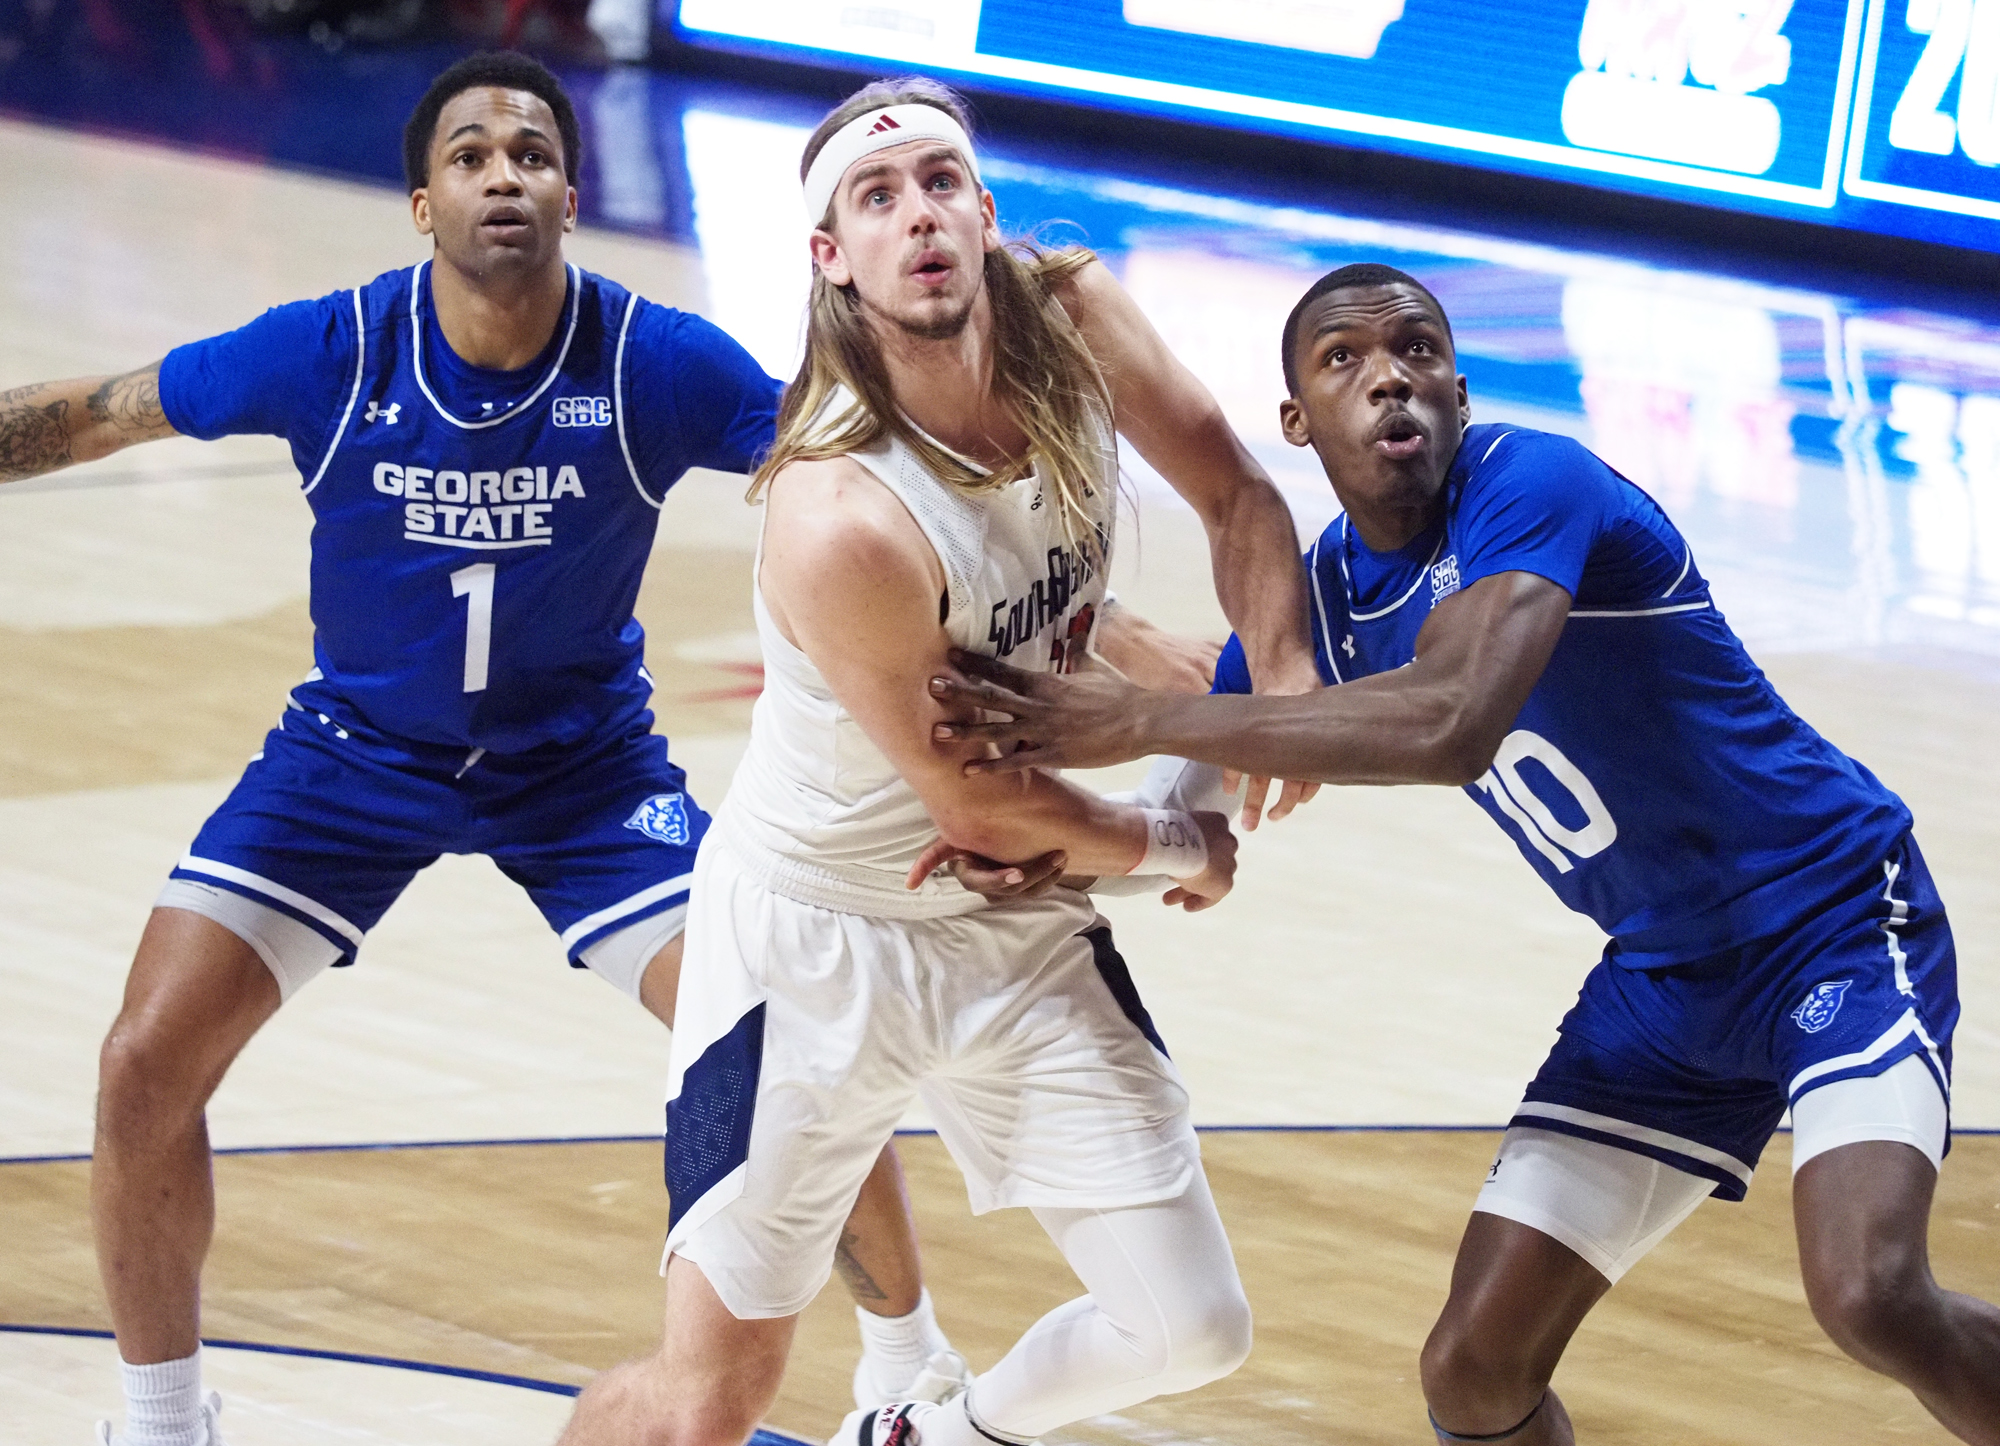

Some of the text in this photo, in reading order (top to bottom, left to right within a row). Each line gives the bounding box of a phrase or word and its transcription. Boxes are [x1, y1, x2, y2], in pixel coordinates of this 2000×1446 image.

[553, 397, 612, 427] SBC
[373, 462, 586, 504] GEORGIA
[405, 503, 553, 540] STATE
[450, 563, 496, 693] 1
[988, 579, 1055, 661] SOUH
[1474, 730, 1618, 875] 10
